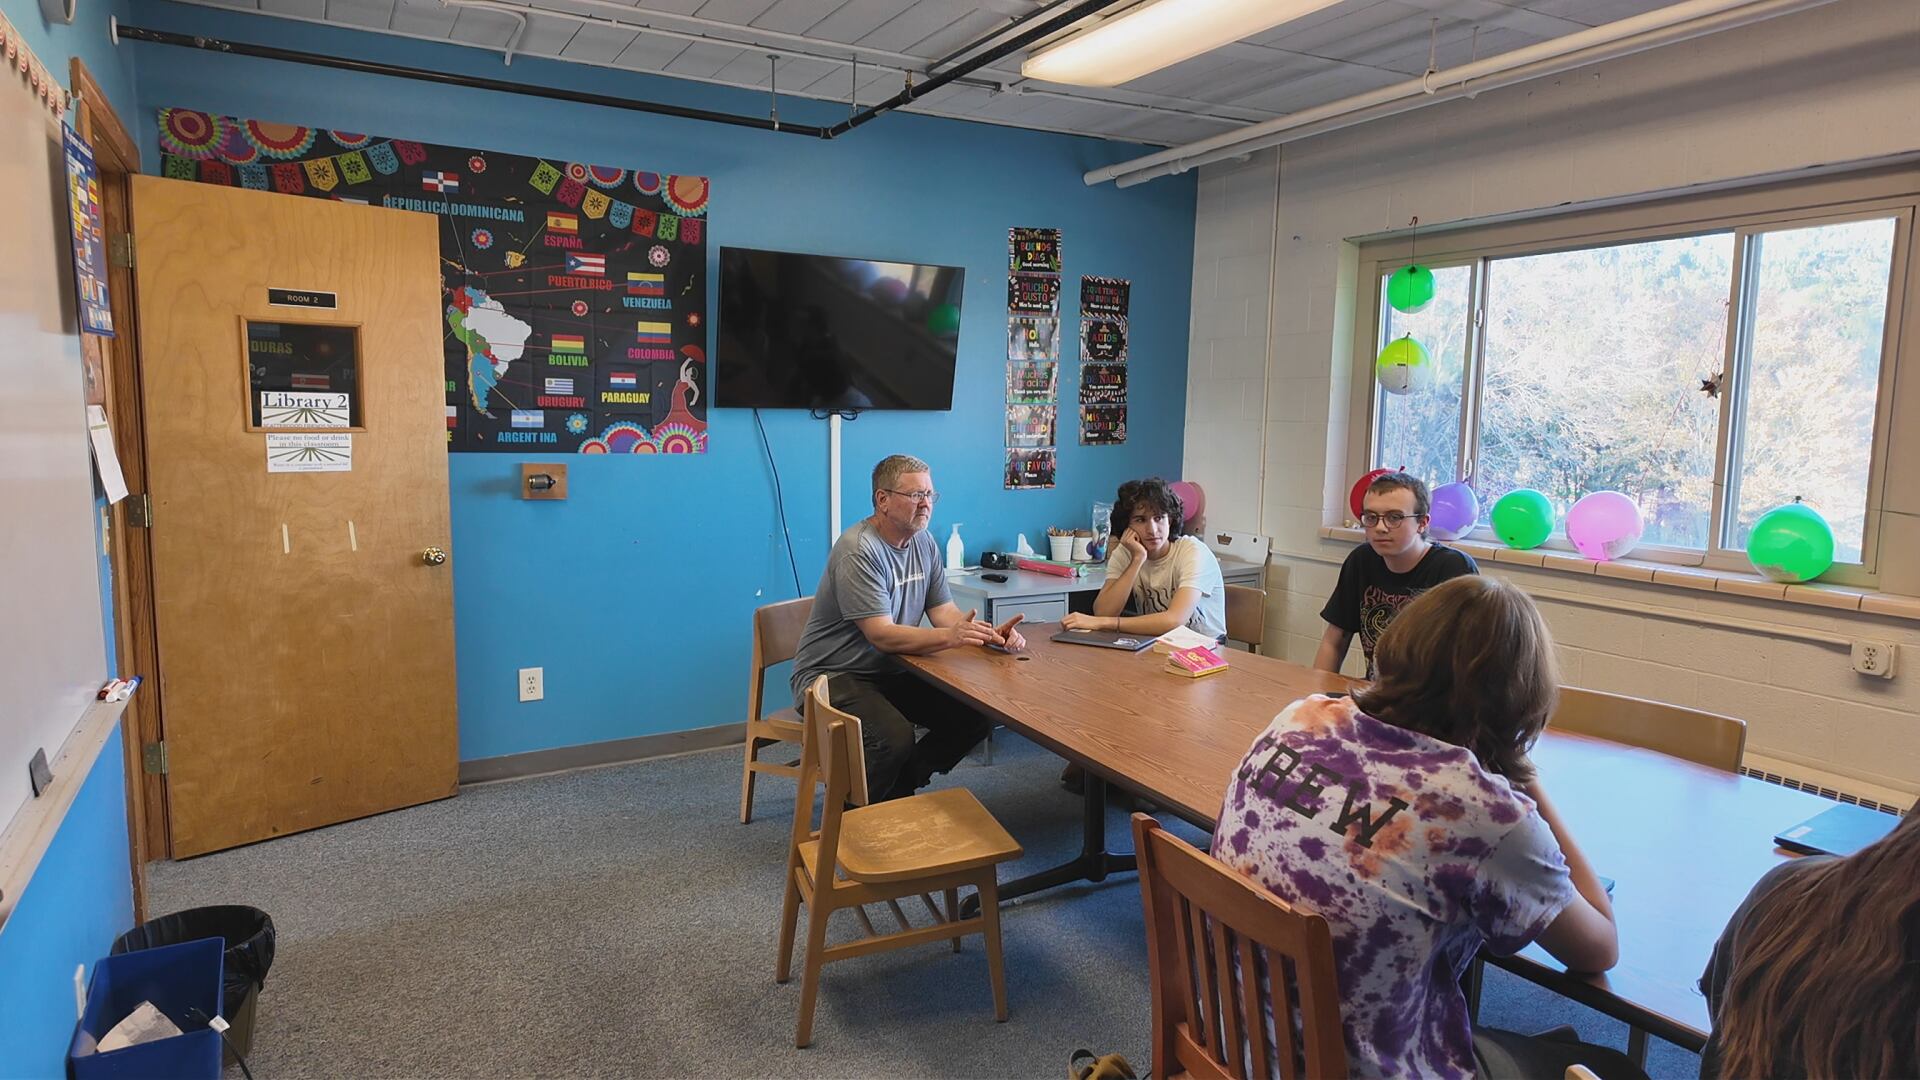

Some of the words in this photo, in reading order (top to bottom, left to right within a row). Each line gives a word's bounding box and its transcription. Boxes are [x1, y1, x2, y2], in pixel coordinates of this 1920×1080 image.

[450, 203, 525, 222] DOMINICANA
[544, 235, 583, 249] ESPAÑA
[548, 275, 586, 288] PUERTO
[1021, 282, 1049, 293] MUCHO
[287, 294, 310, 303] ROOM
[313, 296, 319, 304] 2
[623, 297, 672, 309] VENEZUELA
[1022, 292, 1048, 302] GUSTO
[627, 347, 675, 360] COLOMBIA
[548, 354, 589, 367] BOLIVIA
[263, 393, 331, 412] Library
[338, 395, 347, 408] 2
[601, 392, 650, 404] PARAGUAY
[1027, 461, 1051, 471] FAVOR
